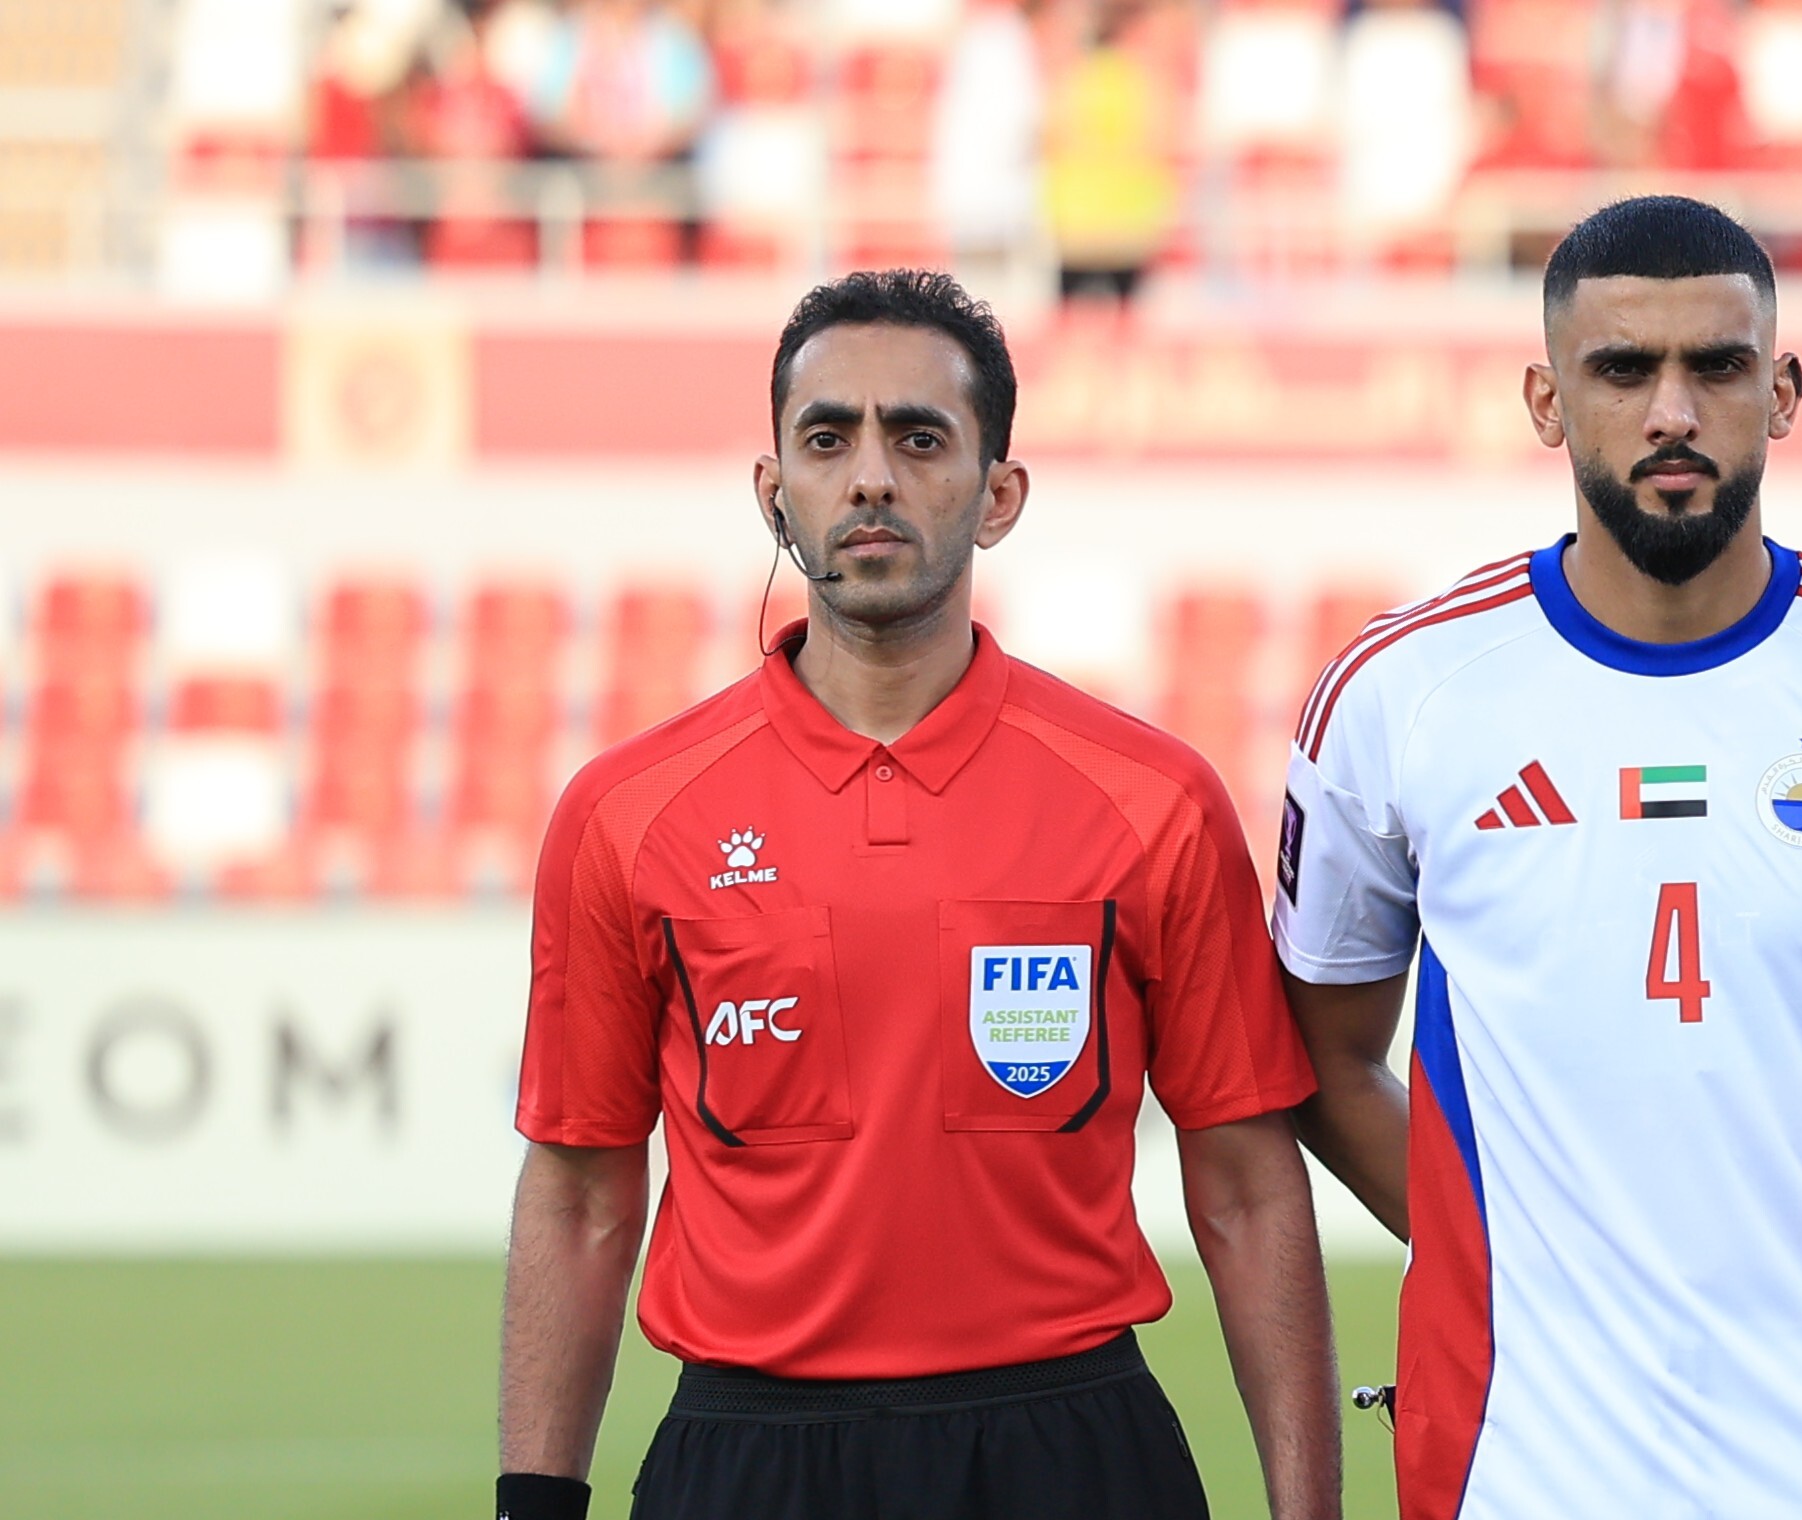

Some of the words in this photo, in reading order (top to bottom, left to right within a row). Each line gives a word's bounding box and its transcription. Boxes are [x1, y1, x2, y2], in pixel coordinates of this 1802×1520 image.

[710, 867, 777, 890] KELME
[1645, 882, 1711, 1023] 4
[983, 957, 1080, 991] FIFA
[705, 996, 803, 1046] AFC
[982, 1009, 1079, 1024] ASSISTANT
[989, 1027, 1071, 1042] REFEREE
[1006, 1066, 1051, 1082] 2025
